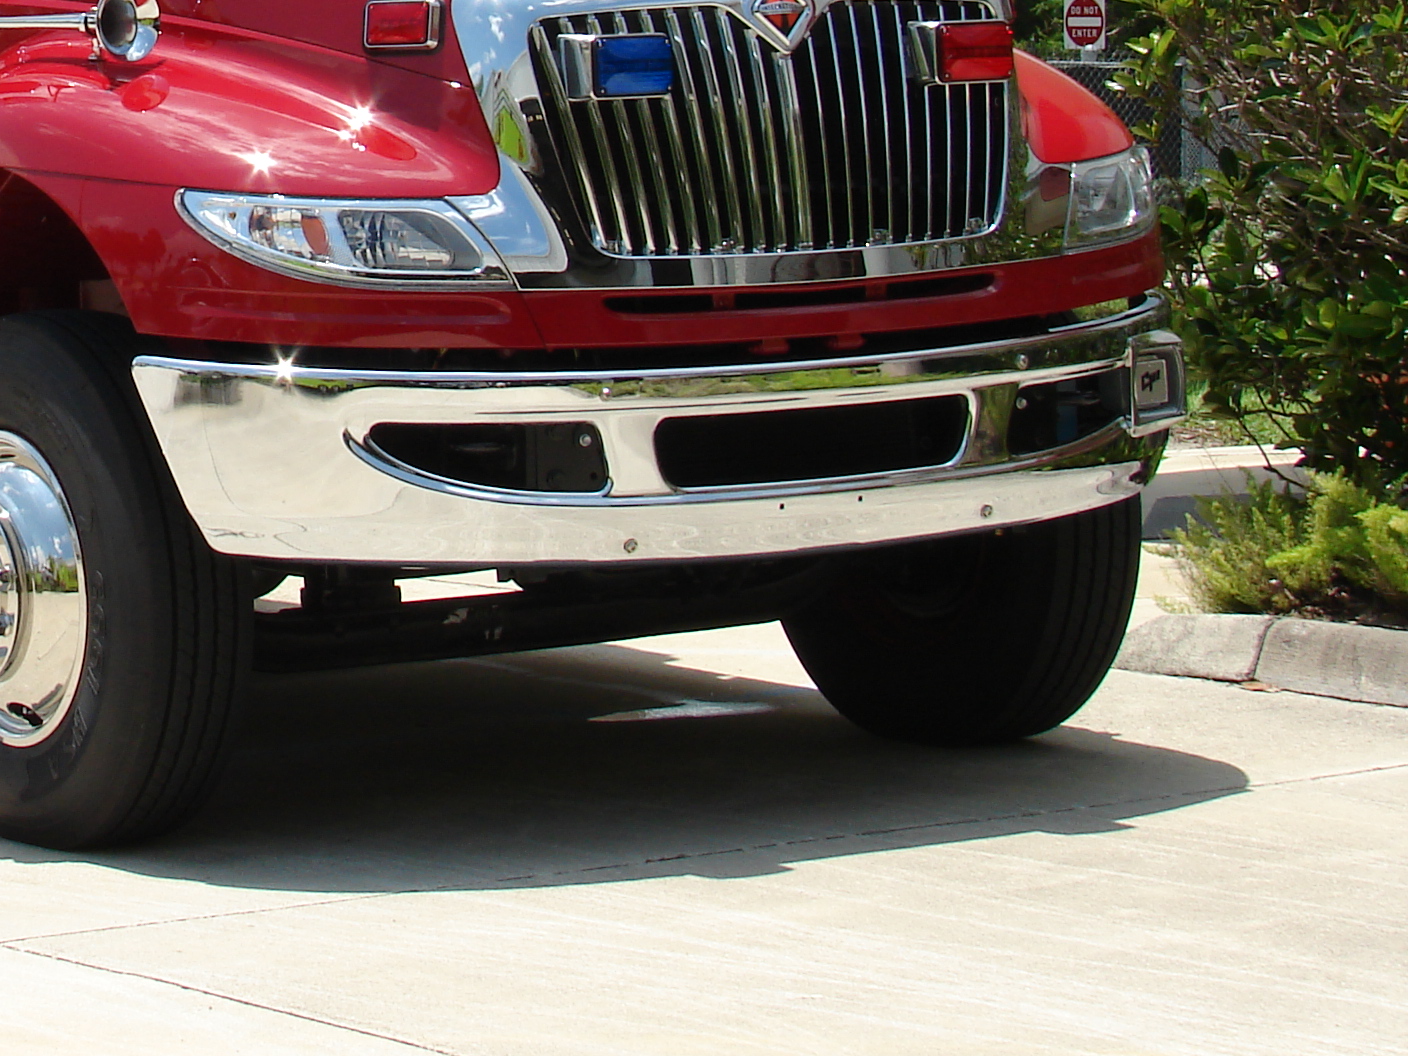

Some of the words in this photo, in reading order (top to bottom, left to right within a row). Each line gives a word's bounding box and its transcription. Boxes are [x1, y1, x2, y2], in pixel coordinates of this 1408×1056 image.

[1070, 6, 1081, 14] DO
[1083, 6, 1099, 14] NOT
[1072, 29, 1097, 38] ENTER
